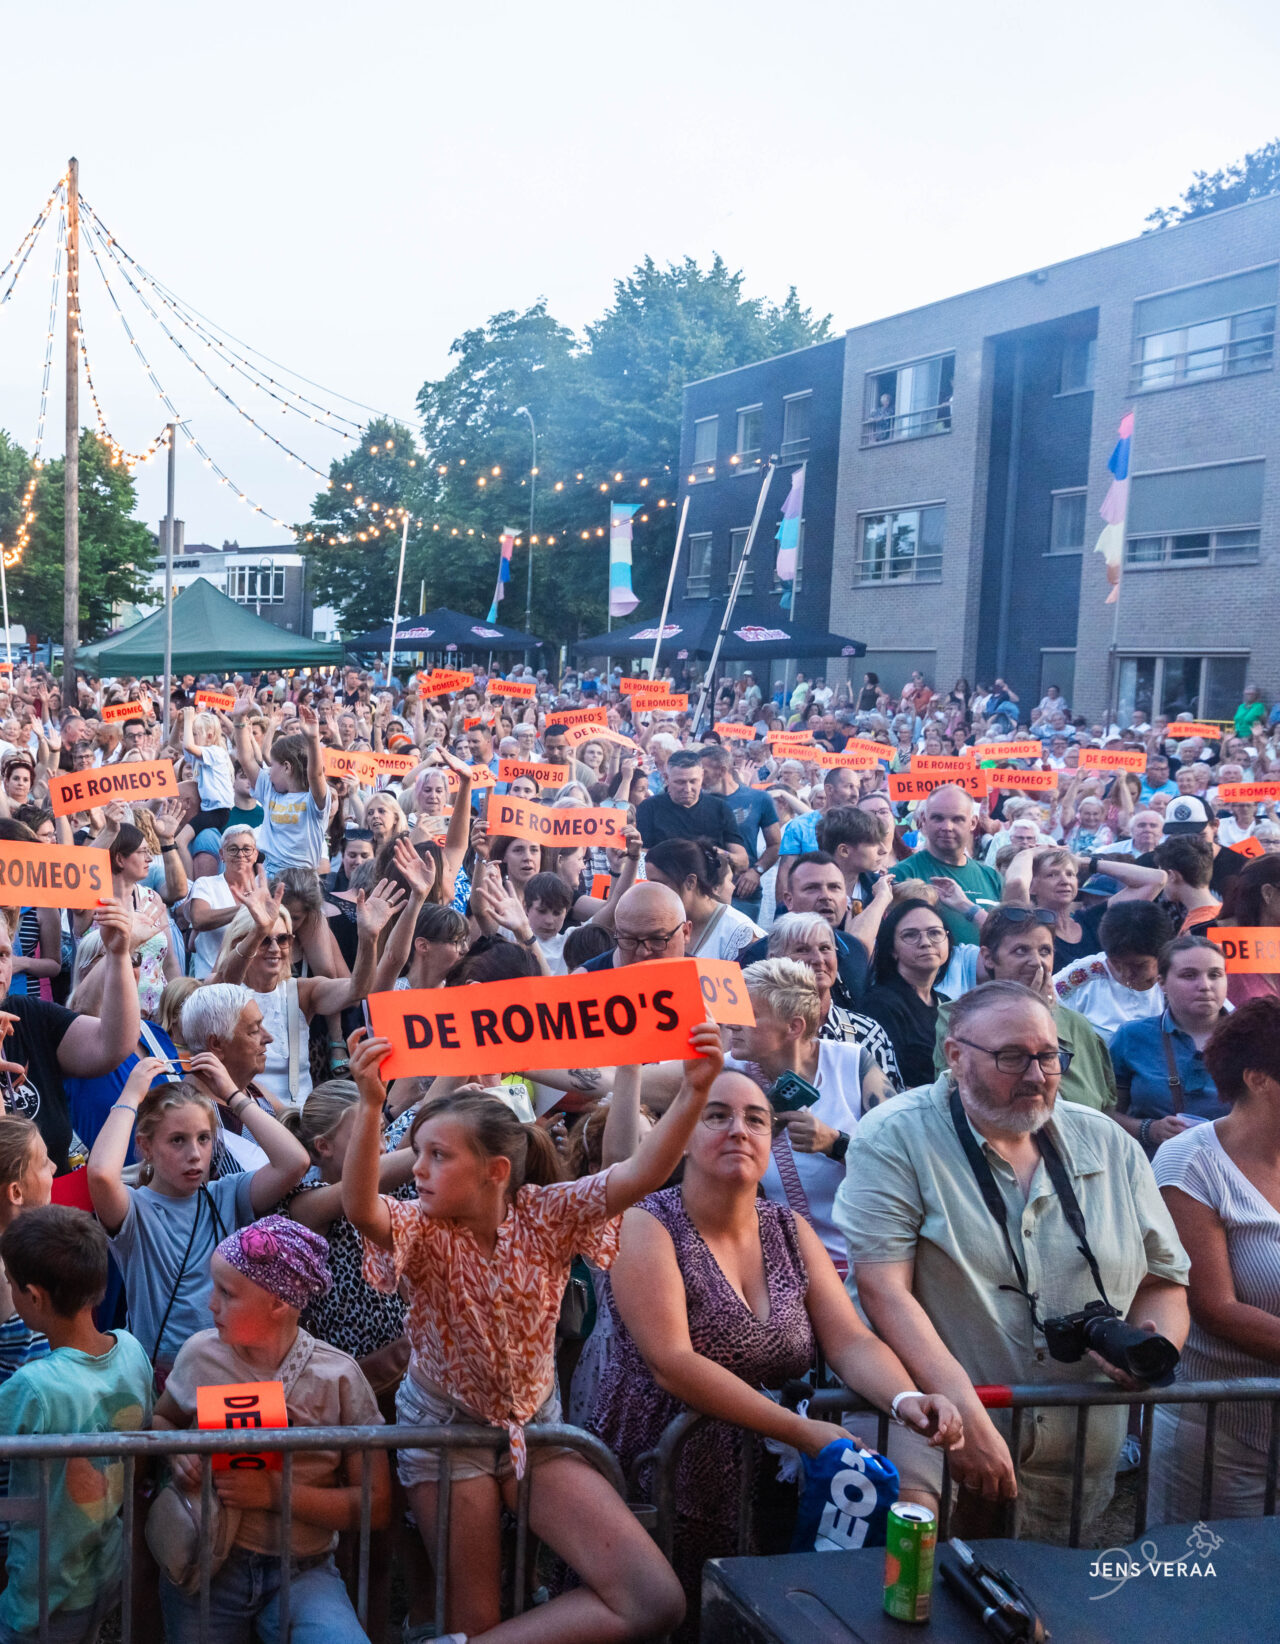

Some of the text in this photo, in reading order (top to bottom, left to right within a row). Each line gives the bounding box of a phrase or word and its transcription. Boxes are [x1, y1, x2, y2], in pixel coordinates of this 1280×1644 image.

[422, 679, 460, 694] DE ROMEO'S
[632, 683, 665, 693] ROMEO'S
[199, 694, 236, 707] DE ROMEO'S
[636, 699, 683, 708] DE ROMEO'S
[106, 705, 143, 719] DE ROMEO
[551, 712, 602, 726] DE ROMEO'S
[574, 728, 589, 739] DE
[727, 726, 752, 736] ROMEO'S
[1173, 726, 1217, 735] DE ROMEO'S
[789, 747, 818, 757] ROMEO'S
[860, 744, 891, 757] ROMEO'S
[985, 747, 996, 755] DE
[998, 745, 1037, 754] ROMEO'S
[835, 757, 874, 765] ROMEO'S
[931, 761, 971, 769] ROMEO'S
[1086, 754, 1142, 766] DE ROMEO'S
[330, 758, 375, 778] ROMO'S
[552, 771, 564, 782] DE
[993, 774, 1052, 785] DE ROMEO'S
[61, 770, 167, 803] DE ROMEO'S
[897, 781, 913, 793] DE
[1224, 787, 1280, 796] DE ROMEO'
[501, 806, 616, 836] DE ROMEO'S
[1223, 940, 1249, 959] DE
[403, 1013, 461, 1049] DE
[471, 990, 679, 1046] ROMEO'S
[223, 1395, 262, 1429] DE
